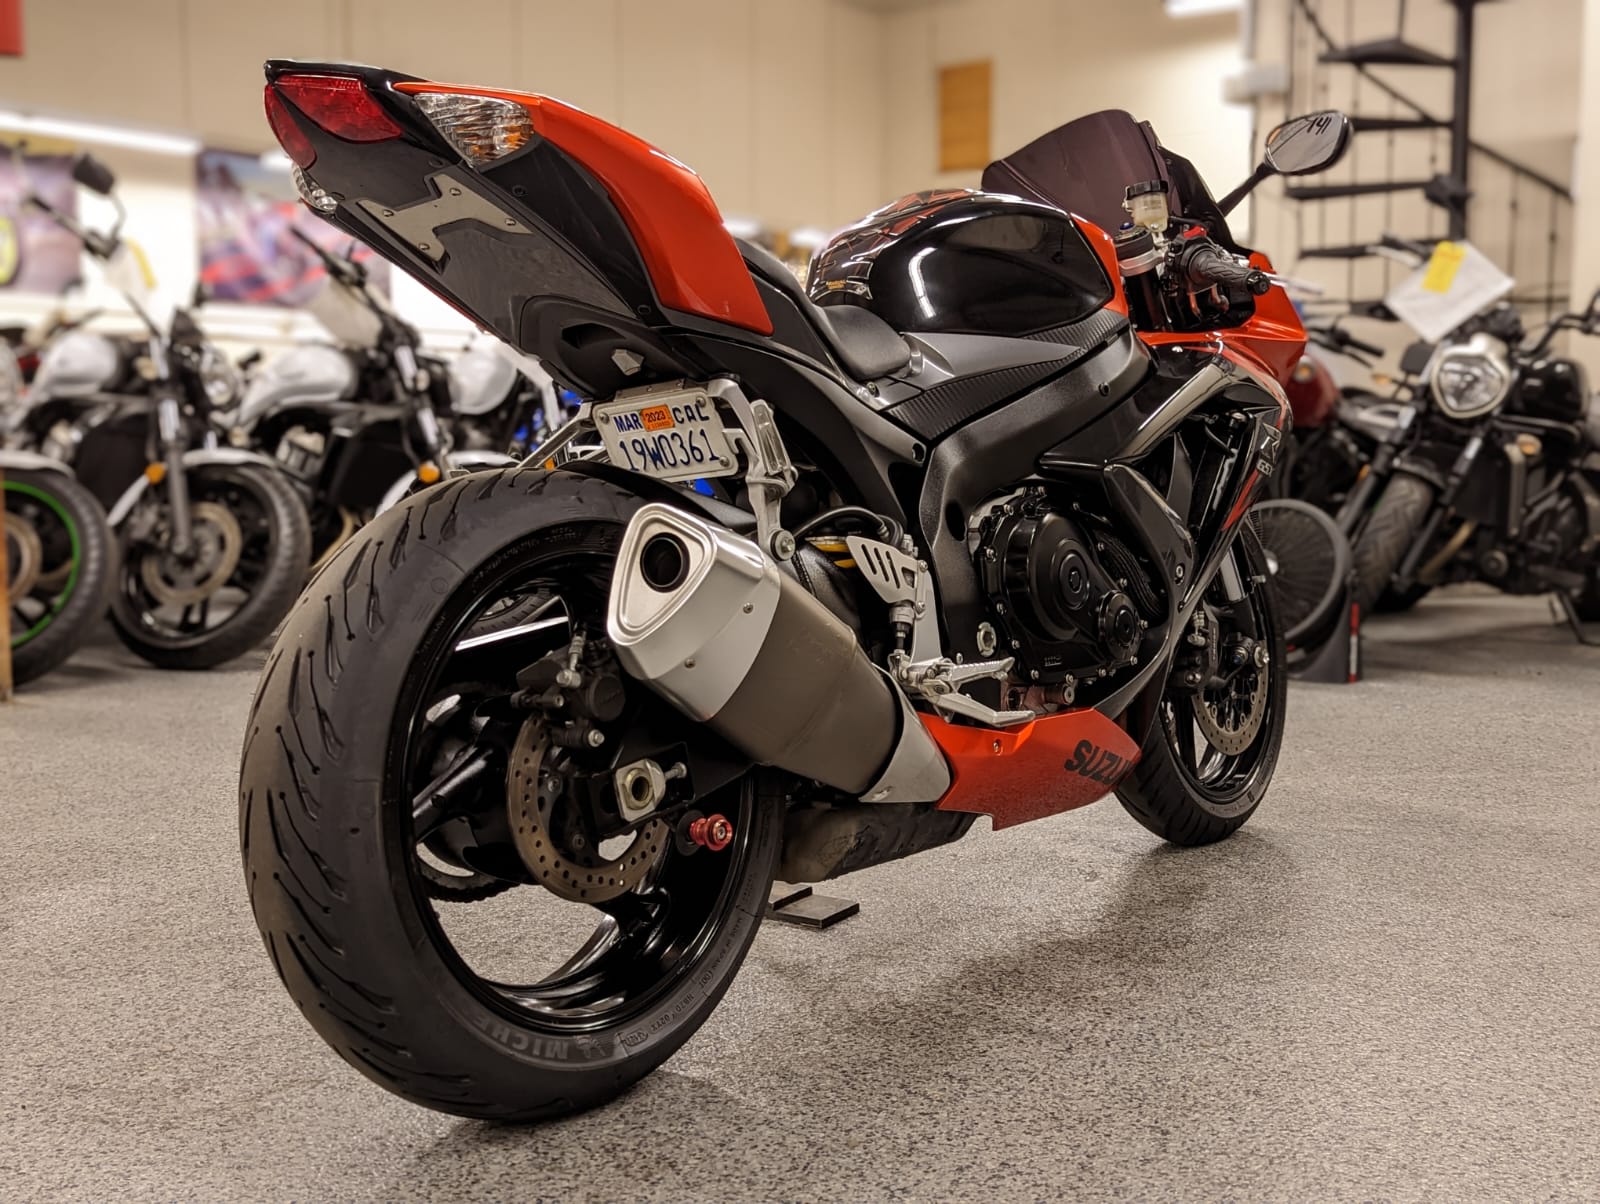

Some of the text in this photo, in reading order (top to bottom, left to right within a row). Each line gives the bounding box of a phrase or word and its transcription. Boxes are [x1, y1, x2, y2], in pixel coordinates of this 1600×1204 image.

[613, 403, 710, 433] MAR 2023 CAL
[619, 428, 720, 472] 19W0361
